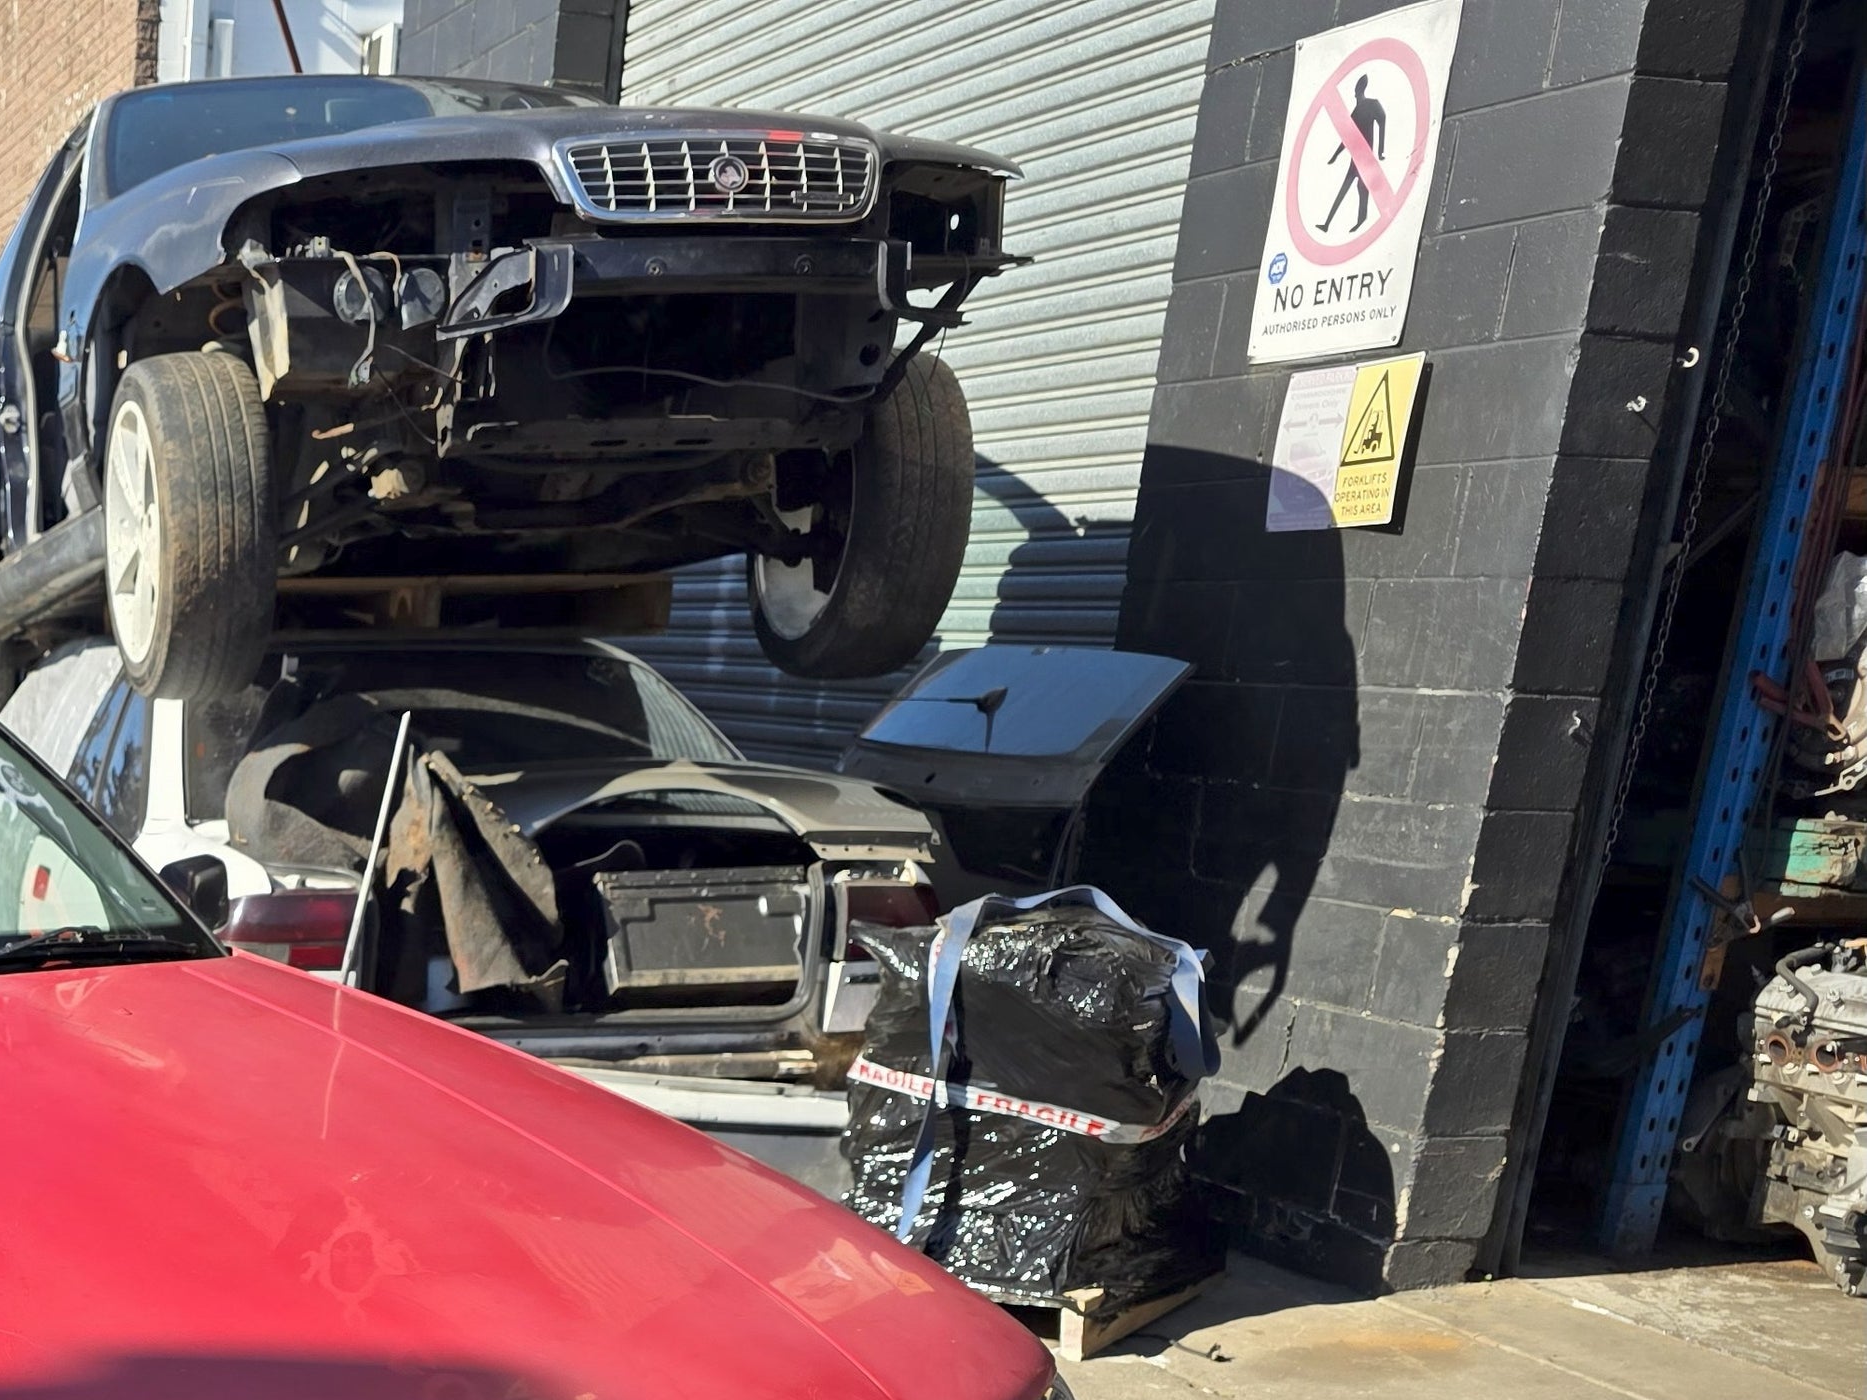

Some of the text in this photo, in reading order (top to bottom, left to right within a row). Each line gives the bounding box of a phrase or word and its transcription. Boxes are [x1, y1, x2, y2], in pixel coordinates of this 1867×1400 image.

[1274, 284, 1304, 313] NO
[1313, 268, 1394, 306] ENTRY
[1262, 305, 1397, 336] AUTHORISED PERSONS ONLY
[1334, 487, 1390, 503] OPERATING IN
[1342, 472, 1387, 488] FORKLIFTS
[1341, 503, 1381, 516] THIS AREA
[858, 1063, 934, 1096] RAGILE
[977, 1093, 1106, 1136] FRAGILE
